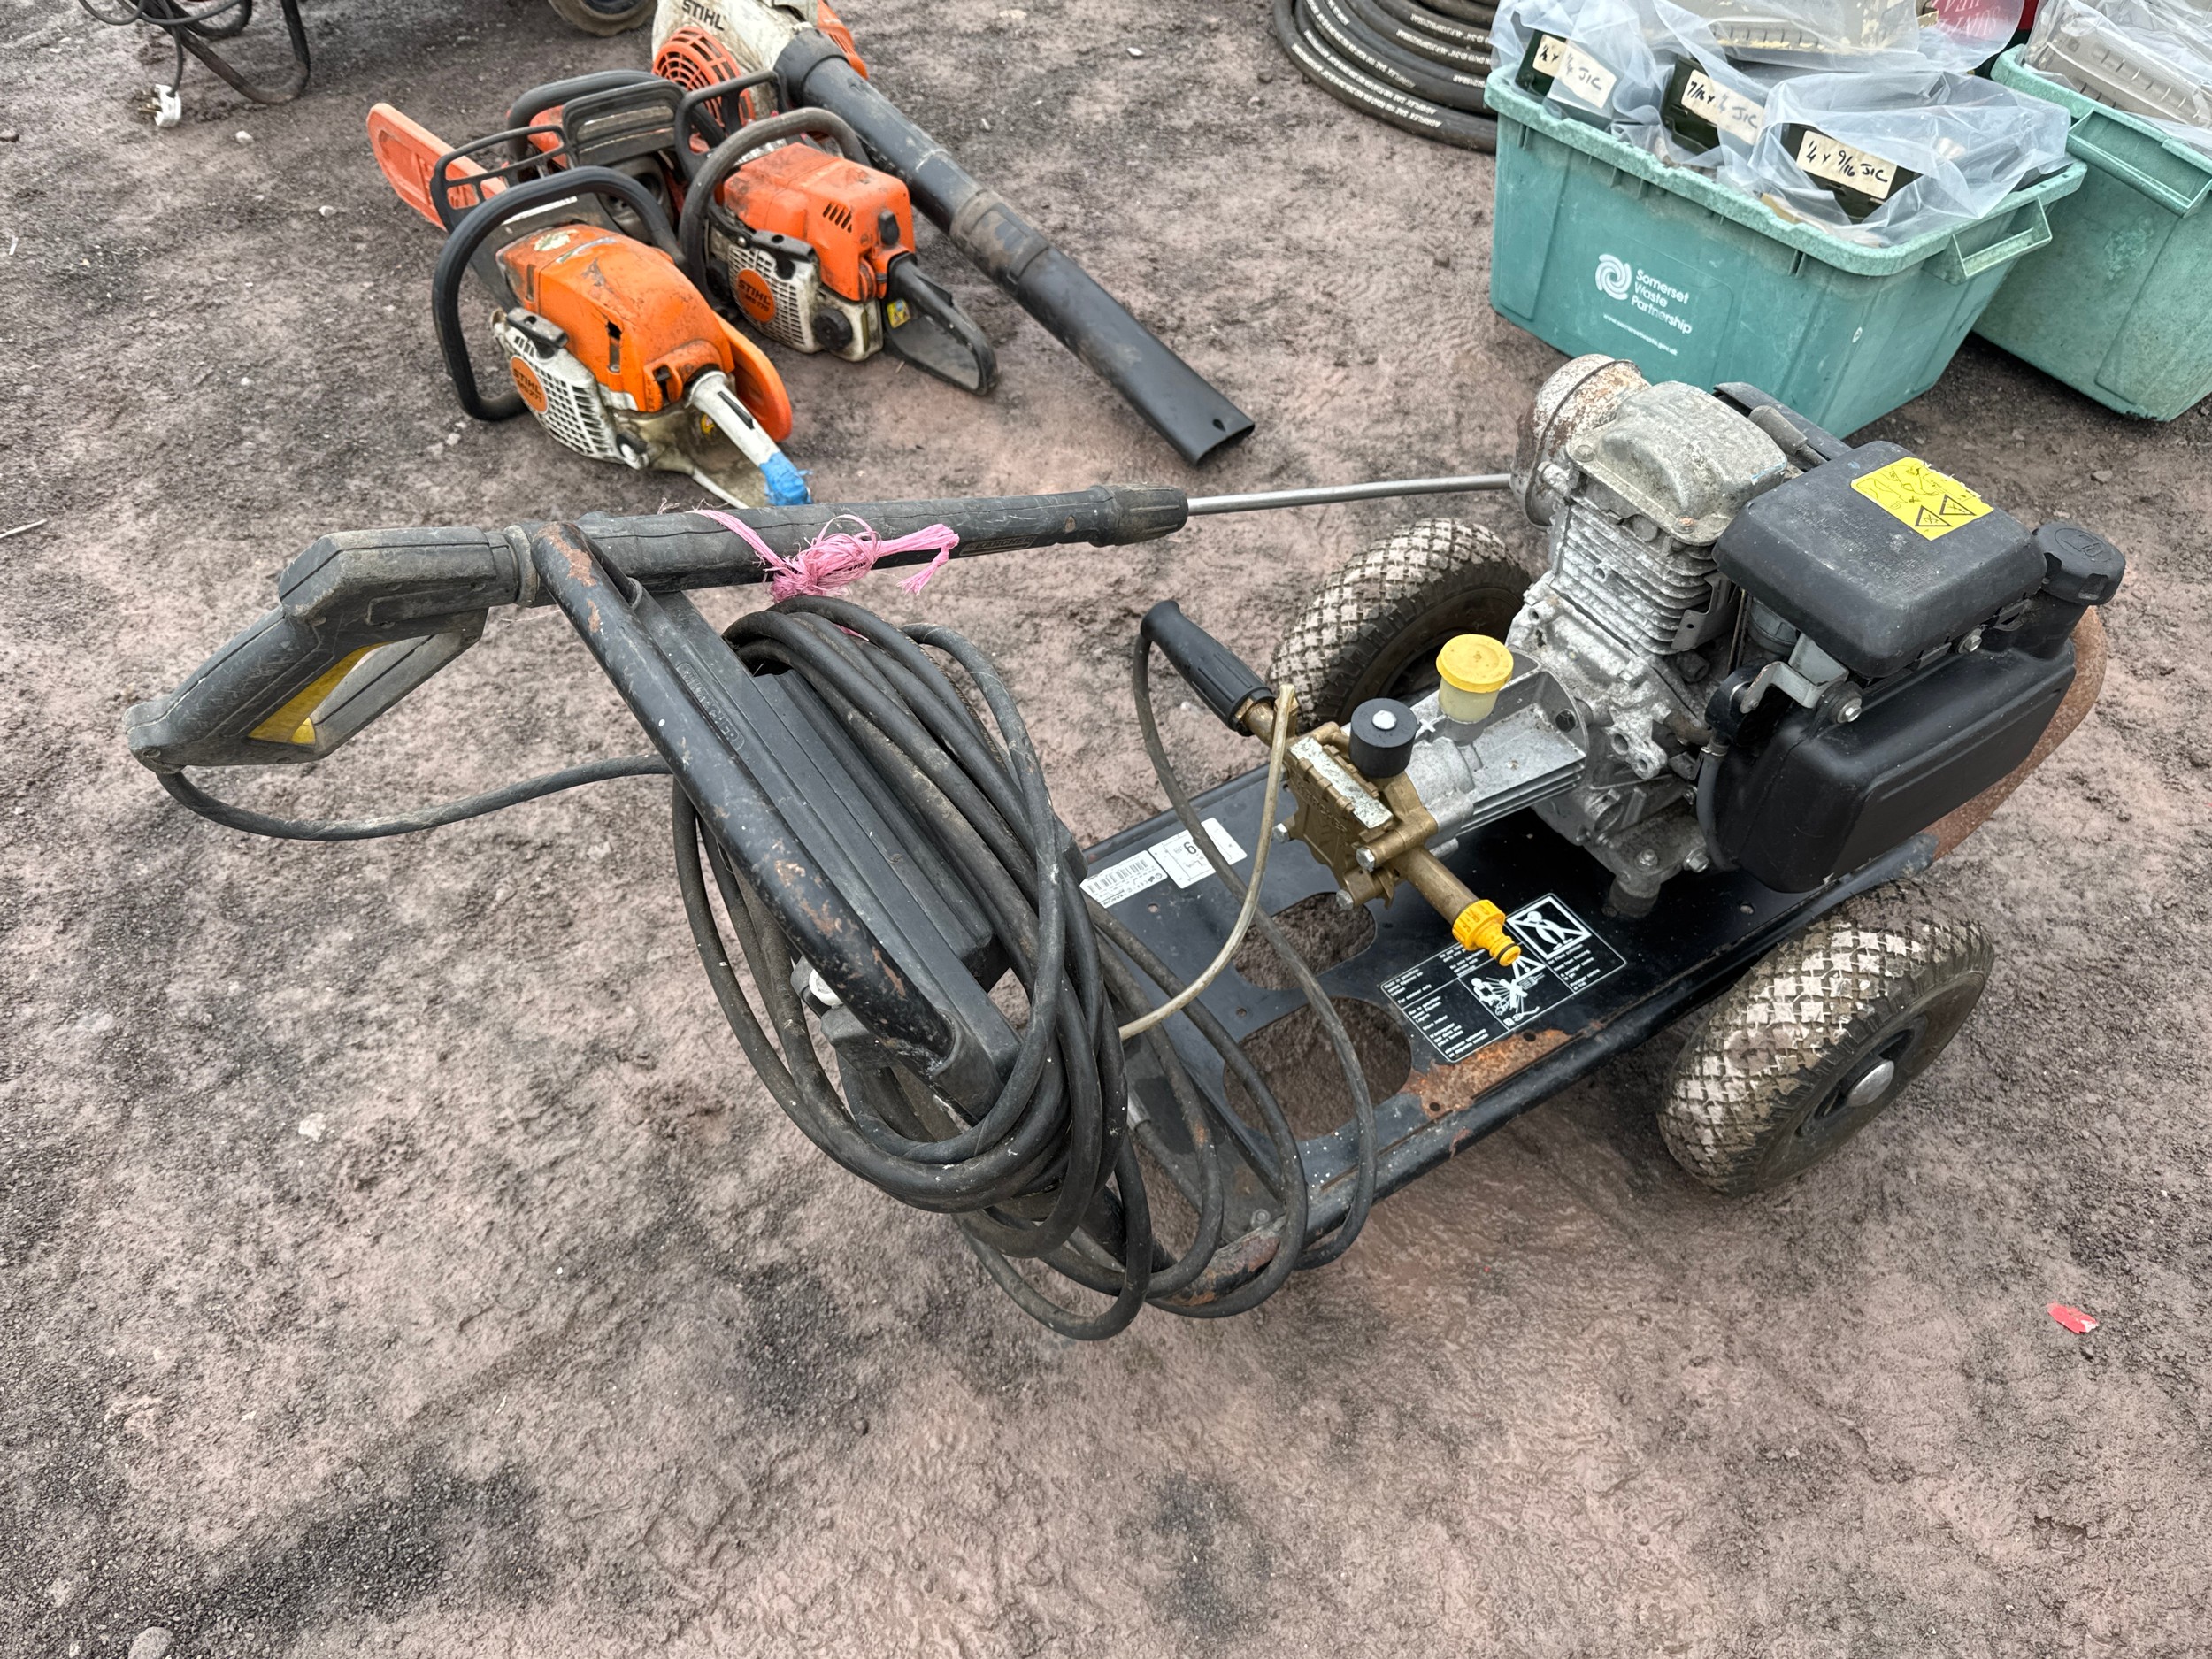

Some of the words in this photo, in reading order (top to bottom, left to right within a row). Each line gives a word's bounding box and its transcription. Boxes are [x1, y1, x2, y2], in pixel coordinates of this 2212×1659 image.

[681, 0, 725, 31] STIHL
[1578, 66, 1602, 92] JIC
[1732, 105, 1759, 130] JIC
[1806, 140, 1817, 163] 1/4
[1838, 150, 1855, 177] 9/16
[1860, 163, 1888, 182] JIC
[738, 279, 771, 306] STIHL
[1634, 281, 1668, 308] Waste
[1636, 269, 1689, 304] Somerset
[1631, 295, 1692, 334] Partnership
[513, 368, 542, 396] STIHL
